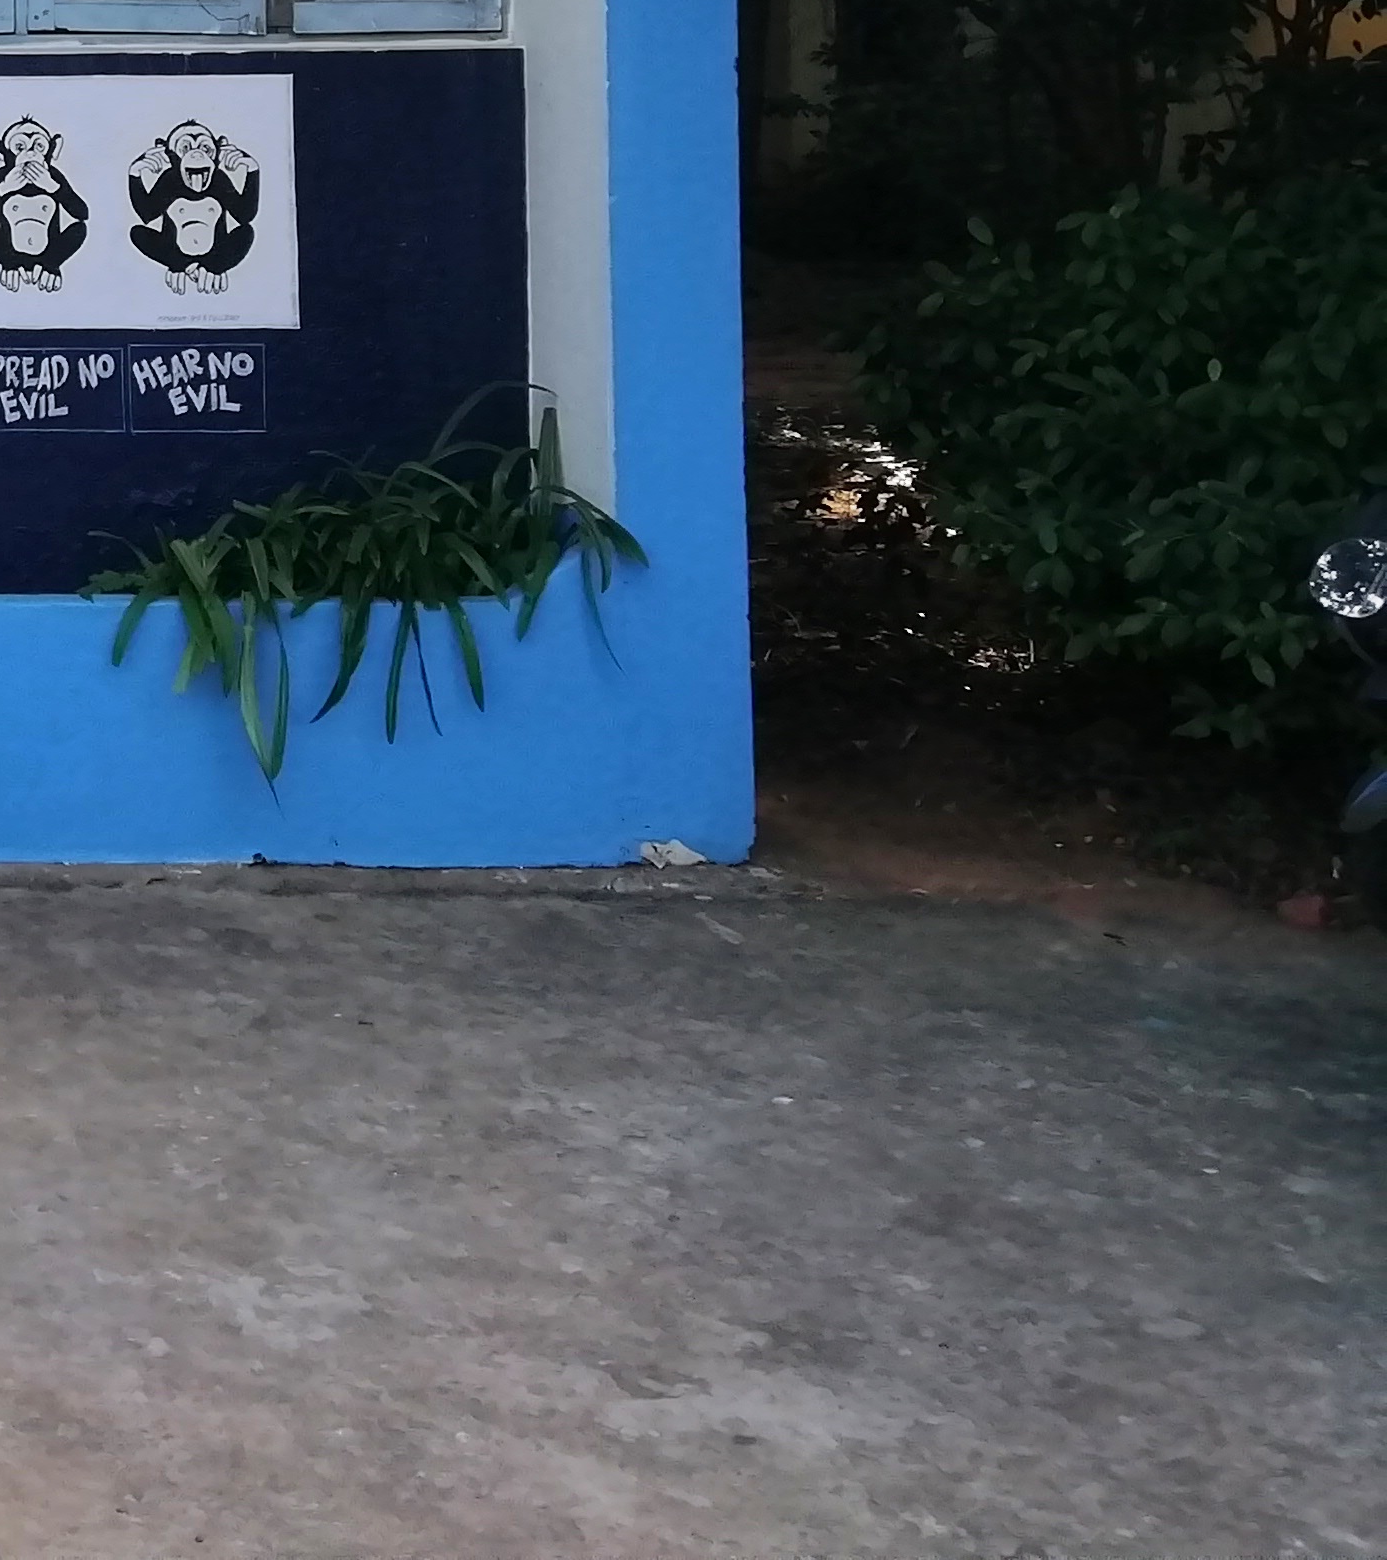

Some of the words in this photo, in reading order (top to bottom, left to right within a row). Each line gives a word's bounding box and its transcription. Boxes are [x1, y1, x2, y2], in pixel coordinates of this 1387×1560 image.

[78, 353, 116, 389] NO
[132, 348, 205, 395] HEAR
[207, 351, 255, 381] NO
[0, 388, 69, 424] EVIL
[168, 382, 243, 416] EVIL
